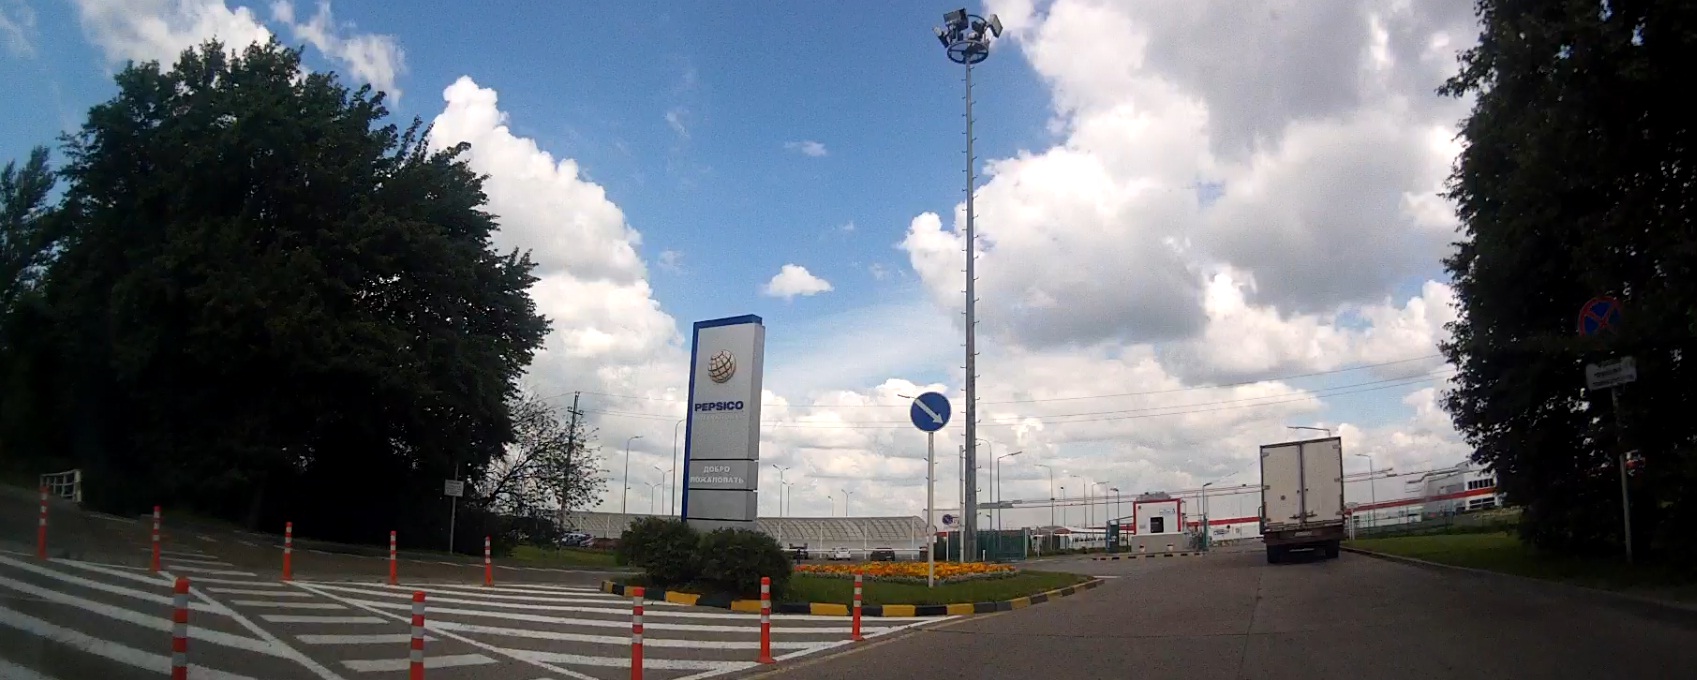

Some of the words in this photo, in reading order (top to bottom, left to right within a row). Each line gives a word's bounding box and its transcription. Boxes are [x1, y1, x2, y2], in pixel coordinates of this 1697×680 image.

[694, 401, 744, 412] PEPSICO
[703, 465, 731, 473] ДОБРО
[690, 476, 744, 484] ПОЖАЛОВАТЬ
